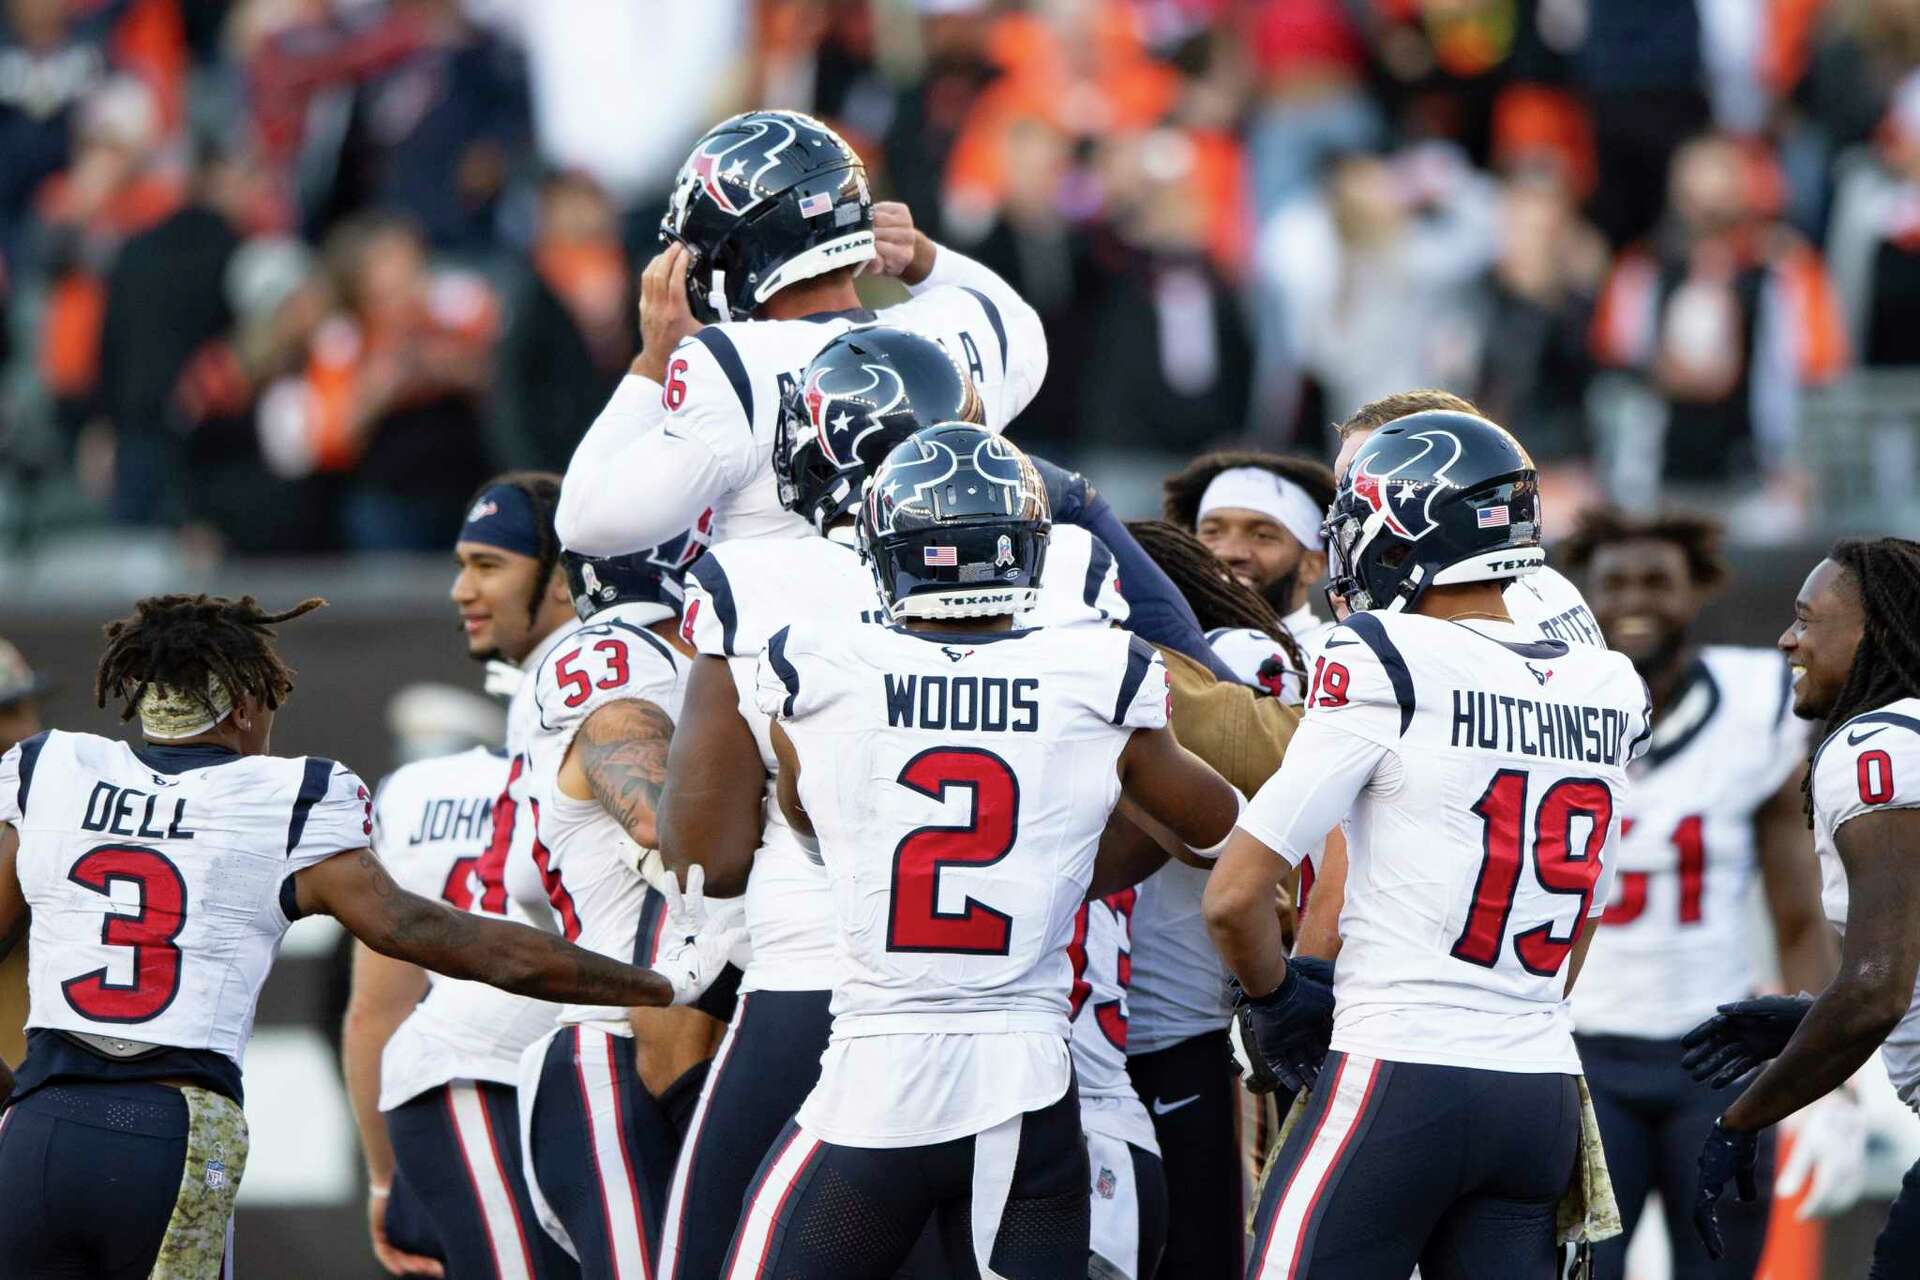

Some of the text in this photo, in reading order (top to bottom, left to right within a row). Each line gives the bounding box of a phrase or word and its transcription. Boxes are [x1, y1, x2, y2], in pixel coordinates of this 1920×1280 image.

[666, 358, 688, 411] 6
[939, 593, 1014, 606] TEXANS
[555, 639, 630, 708] 53
[884, 673, 1039, 732] WOODS
[1308, 655, 1350, 709] 19
[1857, 749, 1894, 805] 0
[81, 781, 195, 839] DELL
[886, 745, 1020, 957] 2
[1449, 767, 1613, 977] 19
[61, 843, 188, 1025] 3
